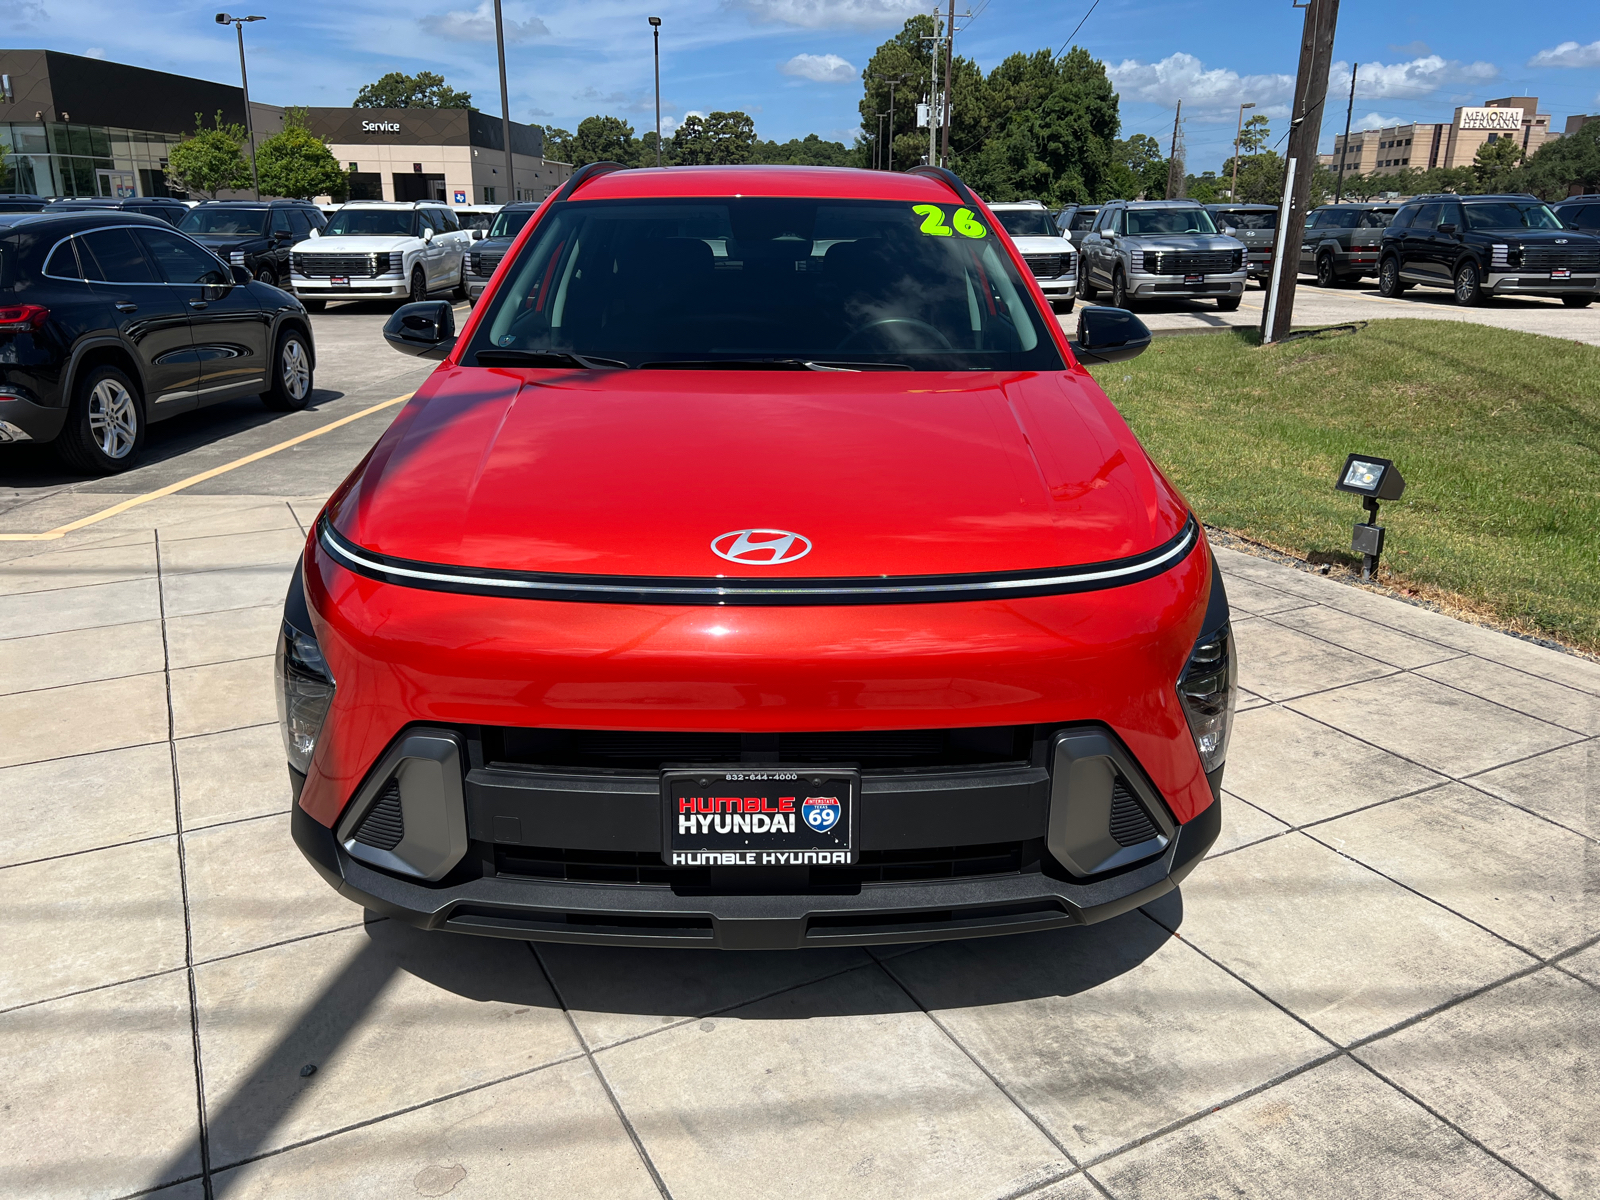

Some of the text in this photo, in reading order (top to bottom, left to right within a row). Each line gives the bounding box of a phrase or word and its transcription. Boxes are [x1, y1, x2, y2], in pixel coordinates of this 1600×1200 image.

[1463, 119, 1519, 128] HERMANN
[1464, 112, 1520, 121] MEMORIAL
[362, 120, 400, 131] Service
[912, 204, 987, 239] 26
[725, 773, 798, 781] 832-644-4000
[679, 797, 796, 813] HUMBLE
[678, 813, 796, 834] HYUNDAI
[808, 809, 835, 826] 69
[672, 851, 851, 865] HUMBLE HYUNDAI
